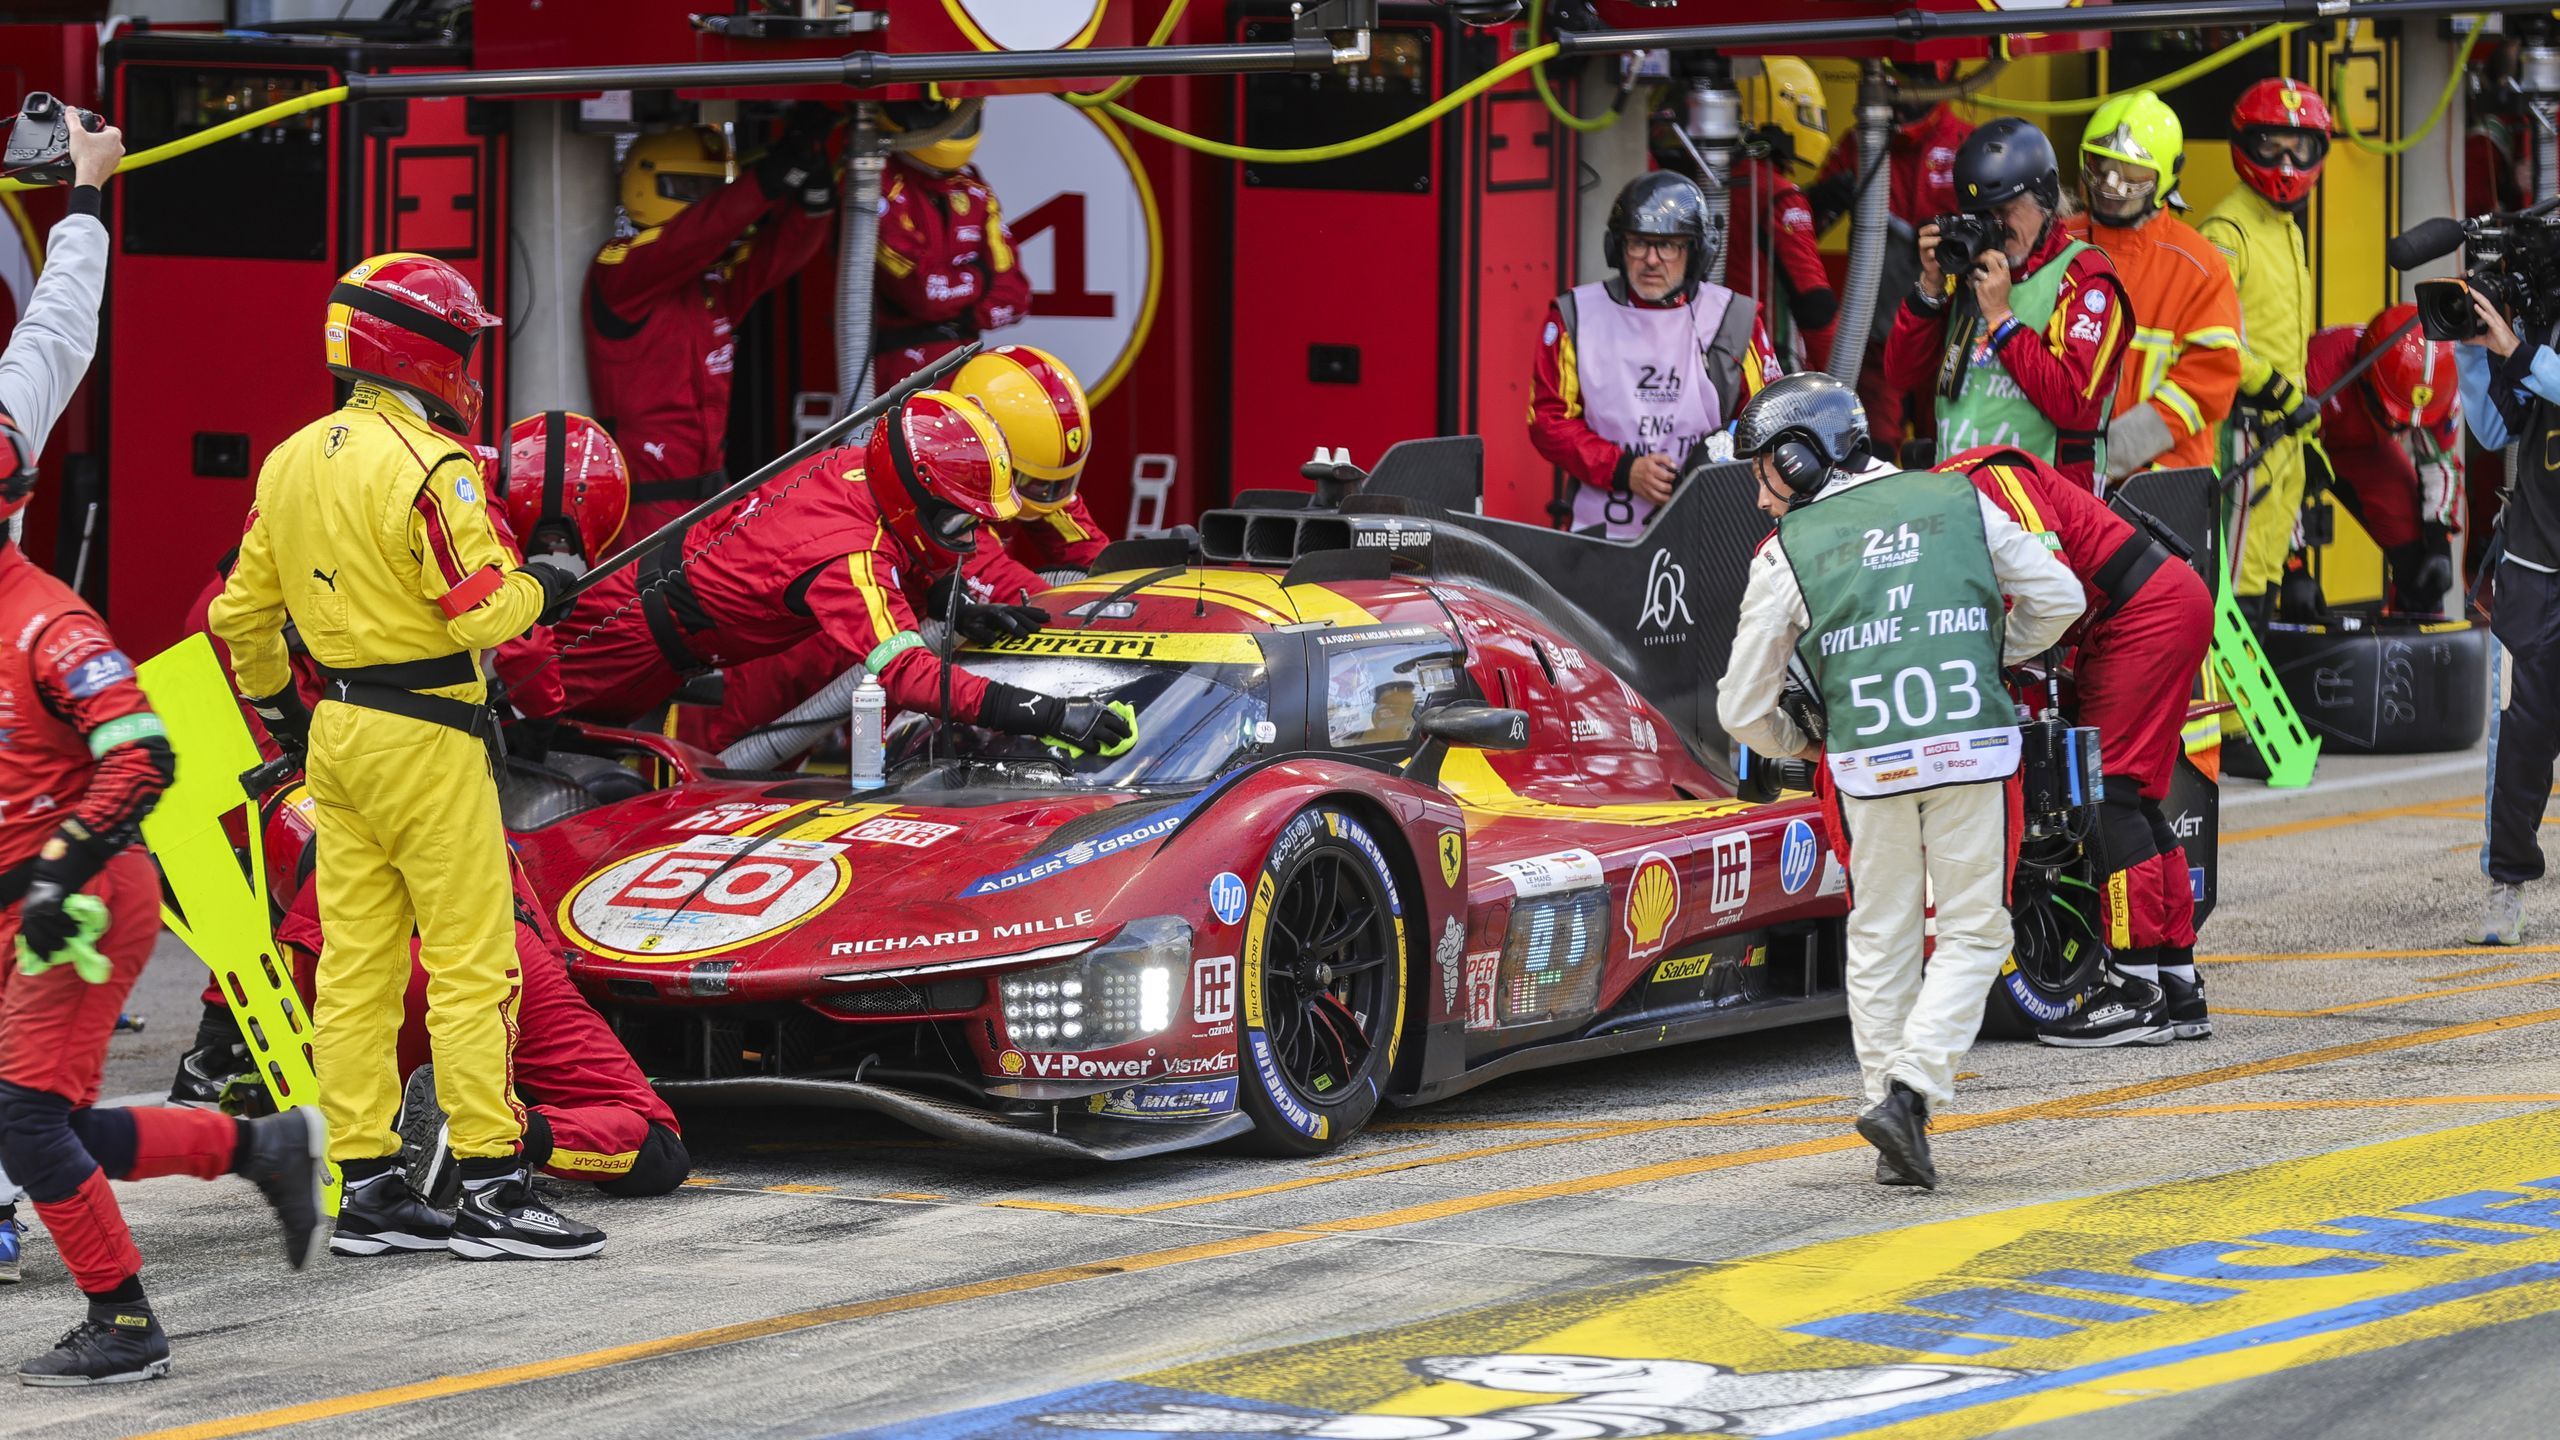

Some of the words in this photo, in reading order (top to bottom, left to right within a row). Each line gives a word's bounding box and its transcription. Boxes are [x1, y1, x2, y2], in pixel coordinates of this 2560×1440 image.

[386, 282, 424, 301] RICHARD
[424, 298, 446, 316] MILLE
[1637, 365, 1680, 389] 24h
[1638, 415, 1674, 437] ENG
[460, 481, 473, 502] hp
[1357, 532, 1388, 547] ADLER
[1401, 532, 1432, 547] GROUP
[1863, 523, 1919, 557] 24h
[1863, 556, 1880, 567] LE
[1882, 548, 1919, 563] MANS
[1886, 583, 1914, 612] TV
[1644, 632, 1687, 647] ESPRESSO
[1820, 617, 1903, 656] PITLANE
[1927, 607, 1988, 636] TRACK
[1851, 659, 1981, 736] 503
[1925, 742, 1959, 756] MOTUL
[1881, 769, 1917, 782] DHL
[1948, 759, 1978, 769] BOSCH
[852, 827, 936, 844] CAR
[870, 820, 951, 834] HYPER
[977, 860, 1063, 893] ADLER
[1098, 817, 1181, 853] GROUP
[1350, 823, 1400, 905] MICHELIN
[1785, 821, 1812, 893] hp
[625, 857, 795, 905] 50
[1215, 874, 1244, 924] hp
[1259, 881, 1272, 907] M
[1716, 910, 1744, 927] azimut
[831, 928, 979, 955] RICHARD
[993, 908, 1093, 939] MILLE
[1250, 937, 1258, 979] SPORT
[1660, 959, 1705, 979] Sabelt
[1250, 982, 1258, 1017] PILOT
[2012, 978, 2067, 1021] MICHELIN
[2088, 1003, 2124, 1022] sparco
[1208, 1022, 1234, 1037] azimut
[1030, 1054, 1152, 1077] V-Power
[1255, 1041, 1308, 1128] MICHELIN
[1141, 1090, 1228, 1109] MICHELIN
[522, 1209, 560, 1226] sparco
